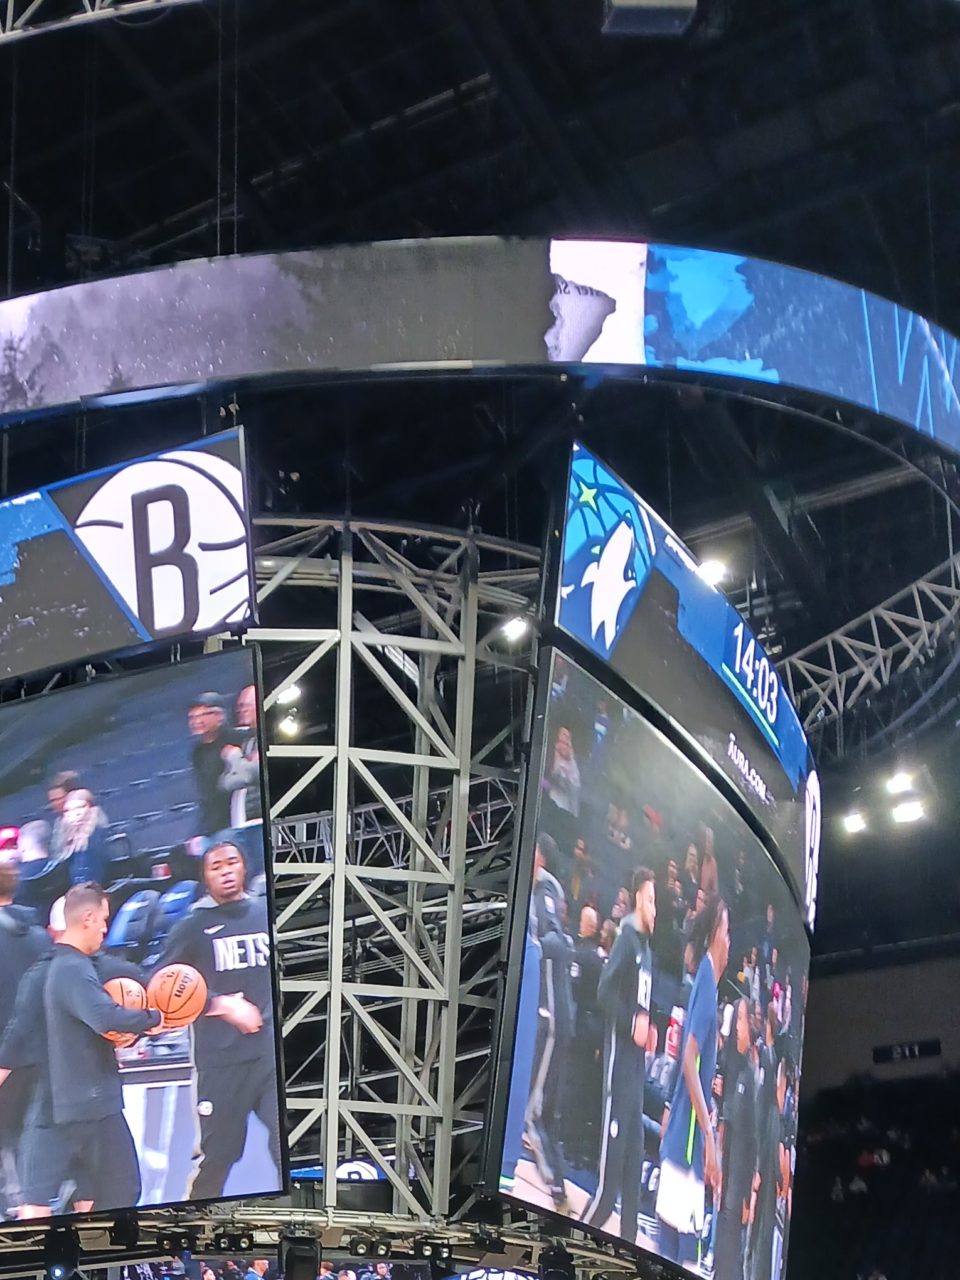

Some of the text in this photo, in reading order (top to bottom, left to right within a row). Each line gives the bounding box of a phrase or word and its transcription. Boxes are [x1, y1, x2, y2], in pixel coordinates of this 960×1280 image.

[132, 483, 200, 633] B
[731, 623, 778, 724] 14:03
[212, 932, 270, 971] NETS
